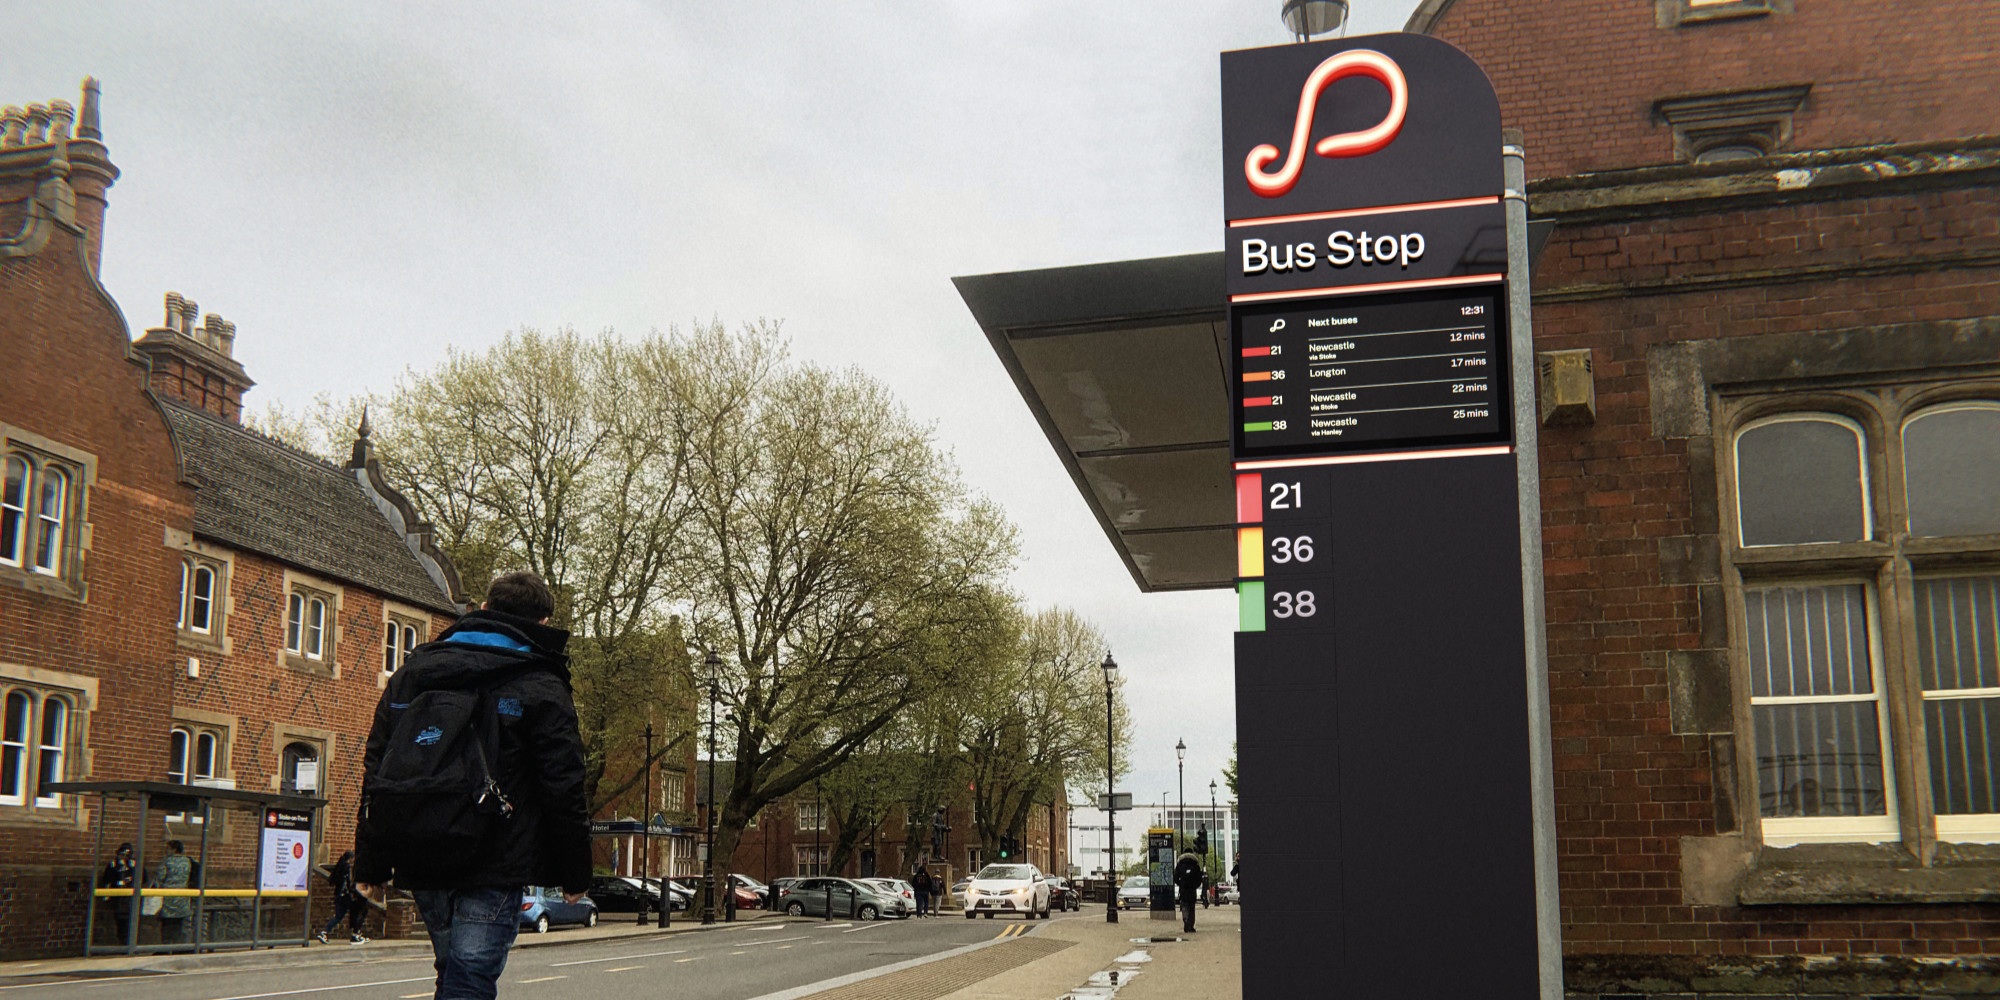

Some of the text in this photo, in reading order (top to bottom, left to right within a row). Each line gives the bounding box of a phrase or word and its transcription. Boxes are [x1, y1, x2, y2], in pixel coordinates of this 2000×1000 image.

[1243, 231, 1424, 272] Bus Stop
[1461, 306, 1483, 315] 12:31
[1308, 317, 1358, 327] Next buses
[1450, 332, 1485, 341] 12 mins
[1271, 345, 1281, 355] 21
[1309, 341, 1355, 352] Newcastle
[1451, 358, 1486, 367] 17 mins
[1272, 370, 1285, 380] 36
[1310, 368, 1346, 377] Longton
[1452, 383, 1487, 393] 22 mins
[1272, 395, 1282, 405] 21
[1311, 392, 1356, 402] Newcastle
[1454, 409, 1488, 418] 25 mins
[1273, 420, 1287, 430] 38
[1311, 417, 1357, 428] Newcastle
[1270, 482, 1301, 509] 21
[1272, 536, 1313, 563] 36
[1273, 591, 1316, 618] 38
[592, 824, 610, 832] Hotel
